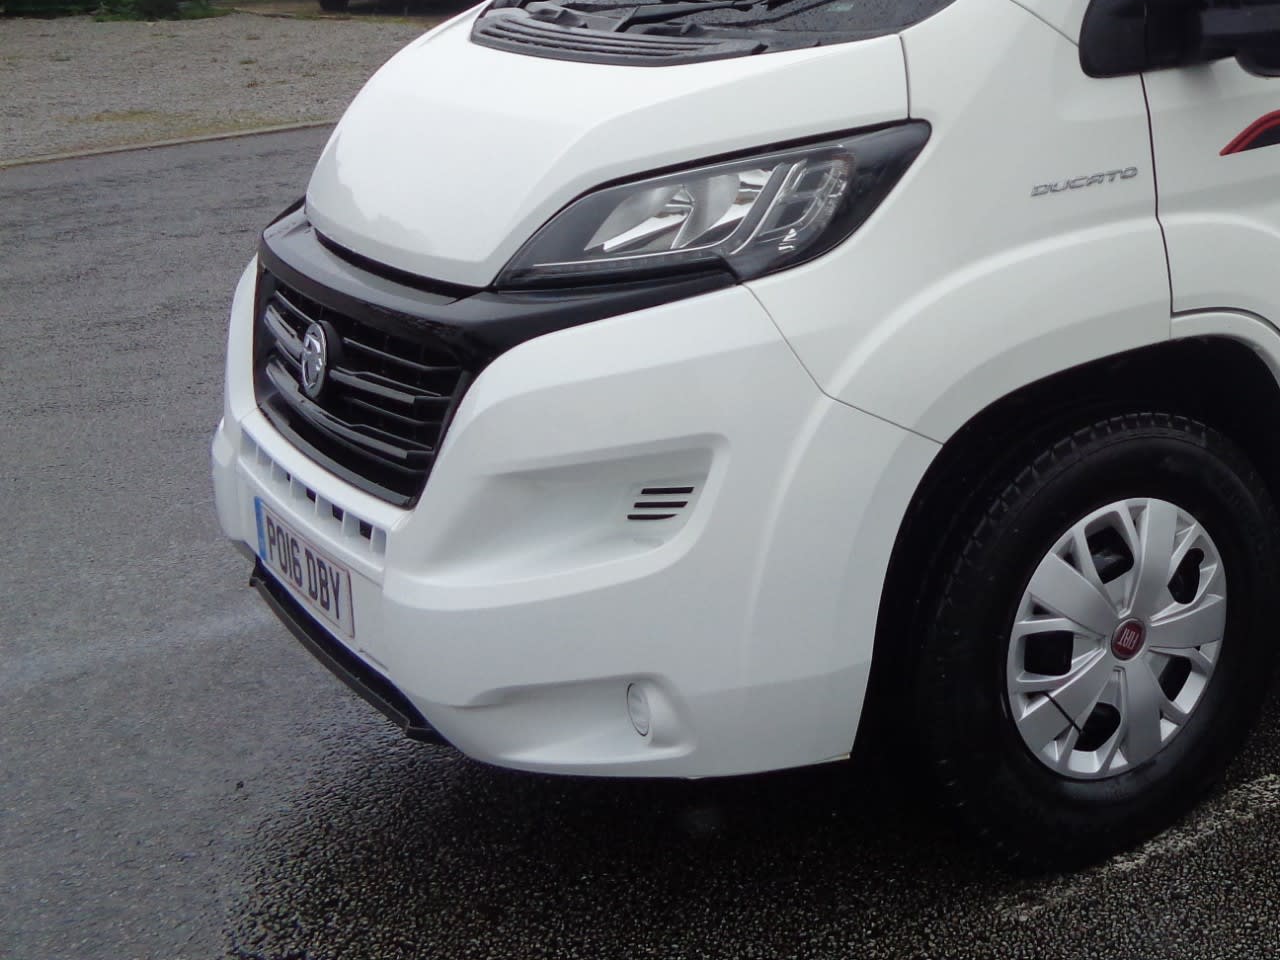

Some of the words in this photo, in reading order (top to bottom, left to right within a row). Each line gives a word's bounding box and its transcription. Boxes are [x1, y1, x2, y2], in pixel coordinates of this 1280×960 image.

[1030, 166, 1139, 197] DUCATO
[266, 514, 304, 588] PO16
[305, 546, 341, 620] DBY
